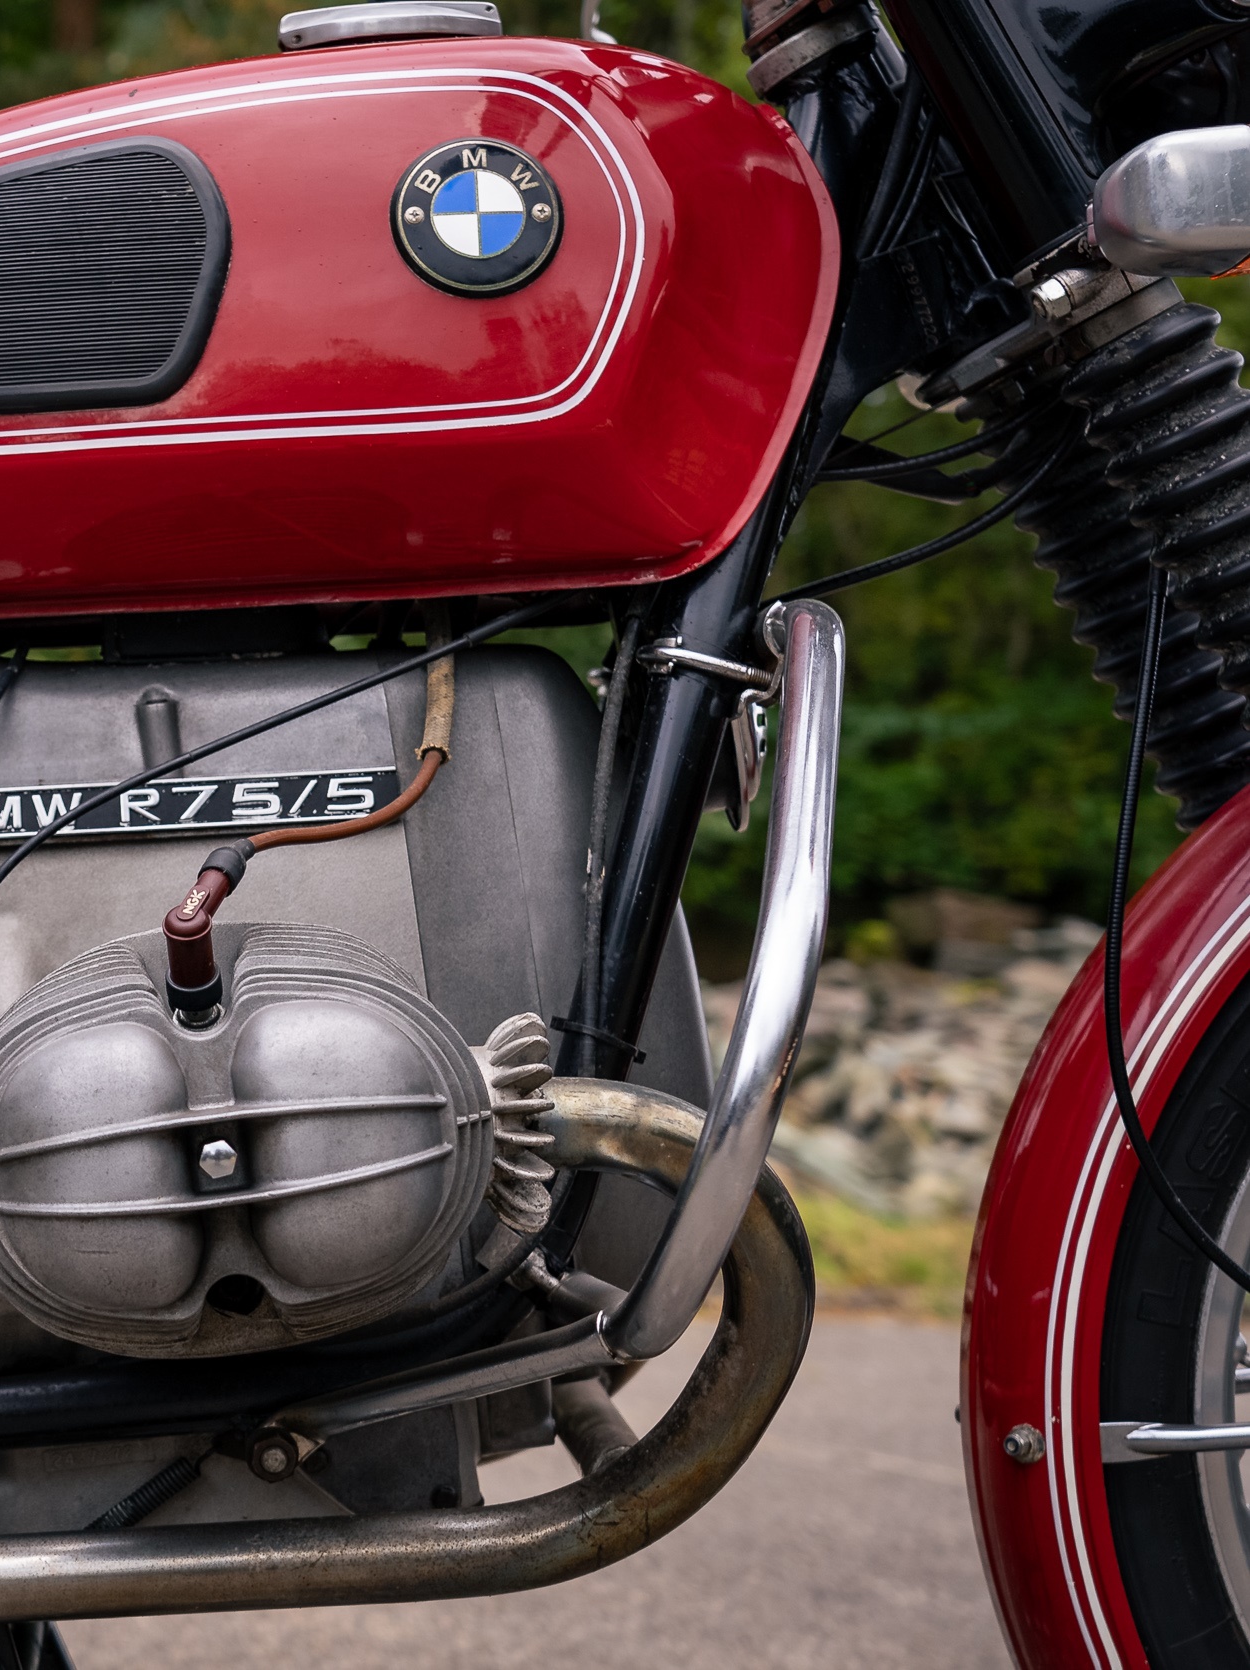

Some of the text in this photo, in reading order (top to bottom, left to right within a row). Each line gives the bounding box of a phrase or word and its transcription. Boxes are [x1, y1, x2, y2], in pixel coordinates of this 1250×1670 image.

[414, 148, 540, 195] BMW
[119, 776, 375, 827] R75/5
[182, 889, 206, 915] NGK
